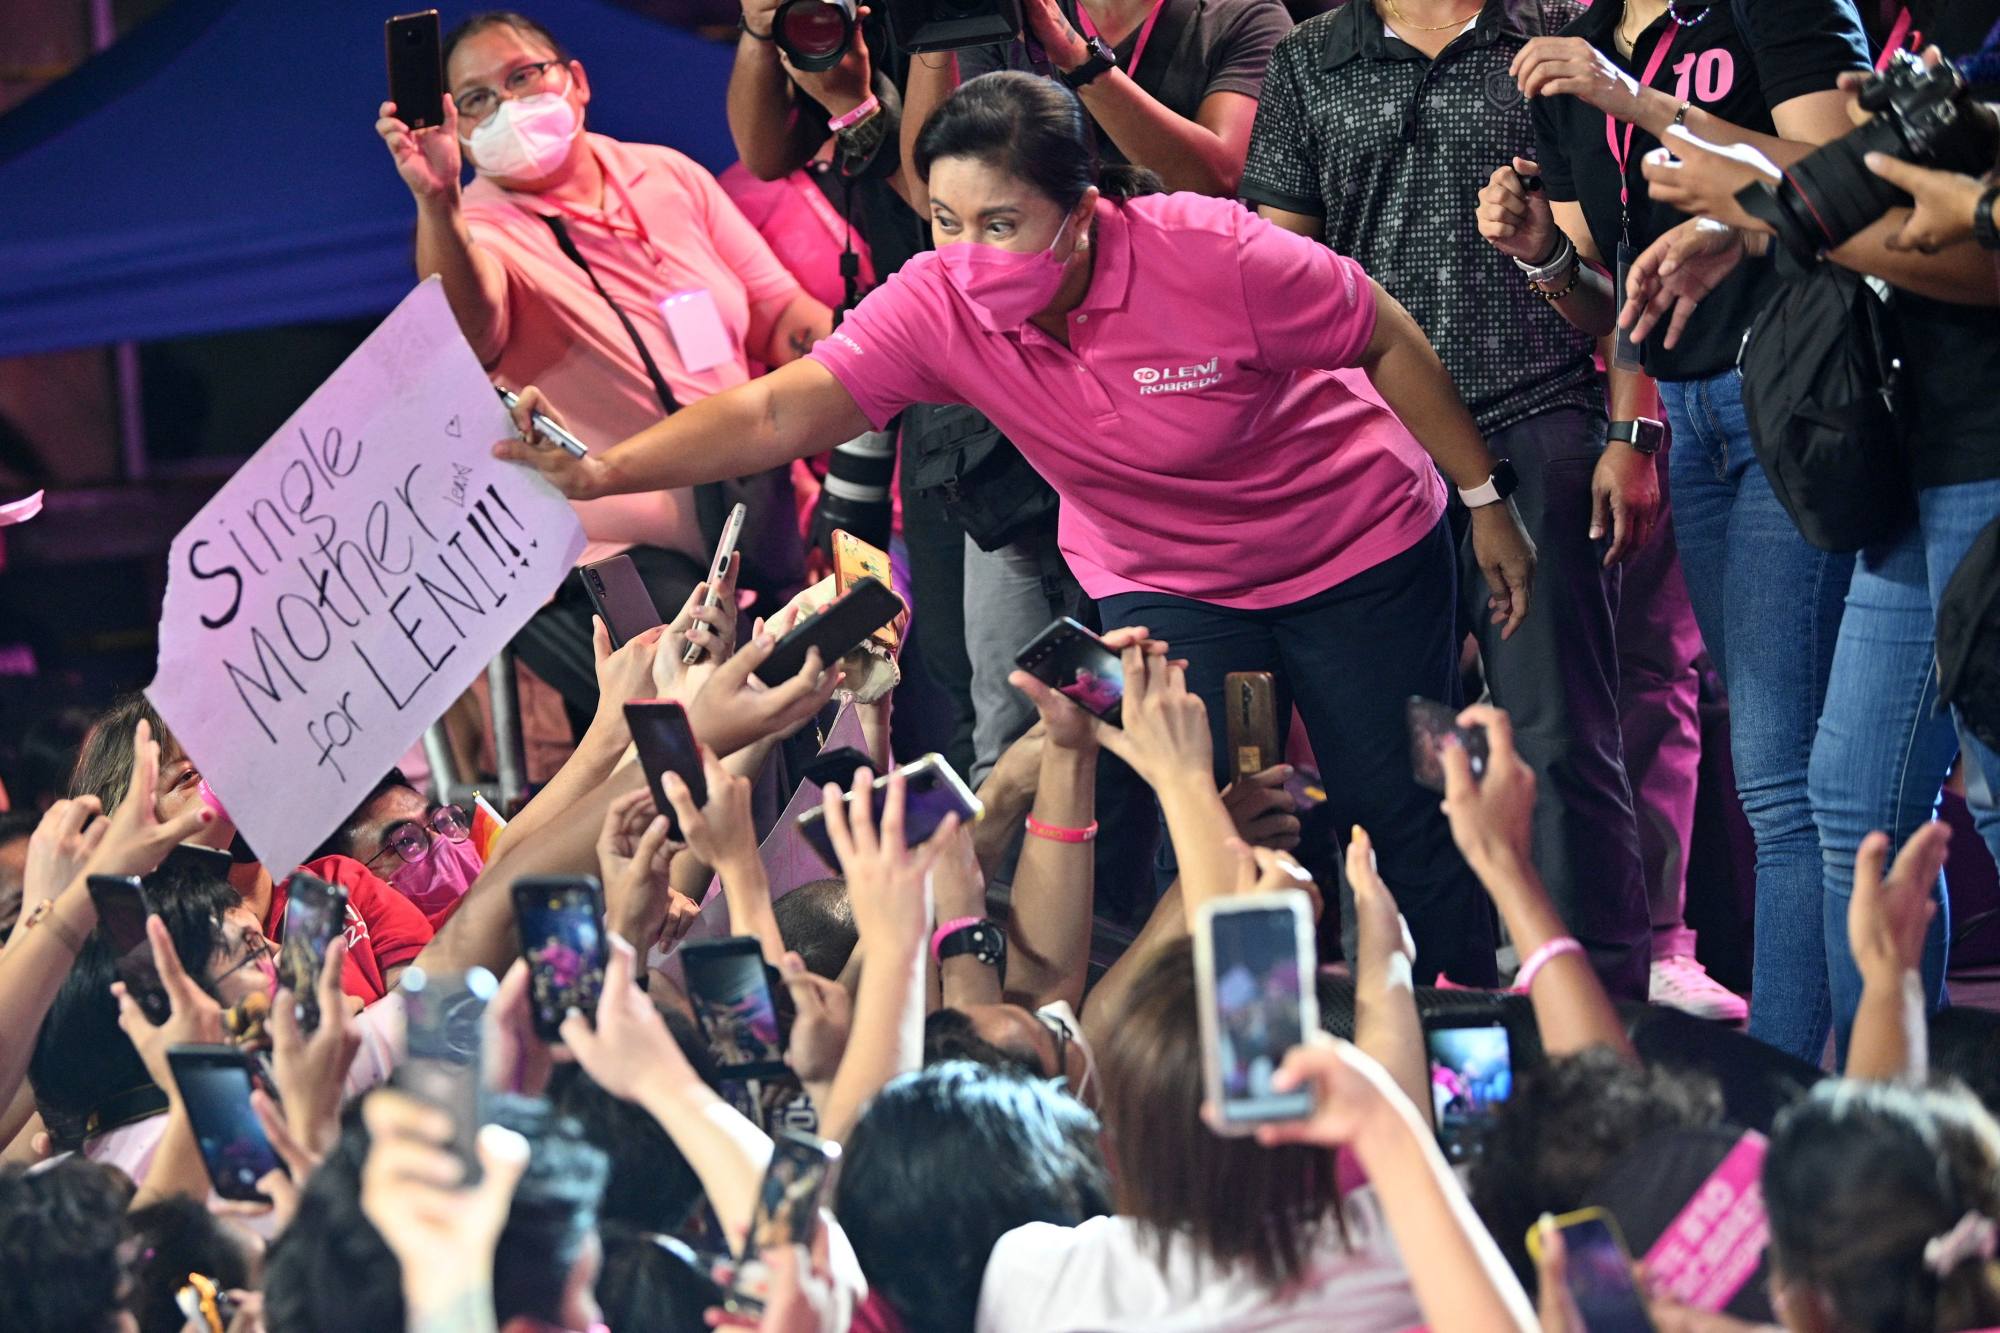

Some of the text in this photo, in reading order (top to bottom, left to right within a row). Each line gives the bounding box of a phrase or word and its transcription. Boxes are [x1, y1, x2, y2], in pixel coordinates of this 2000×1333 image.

[1673, 47, 1734, 103] 10
[1140, 372, 1222, 395] ROBREDO
[1163, 357, 1218, 380] LENI
[188, 426, 363, 630] Single
[306, 483, 539, 783] for LENI!!!
